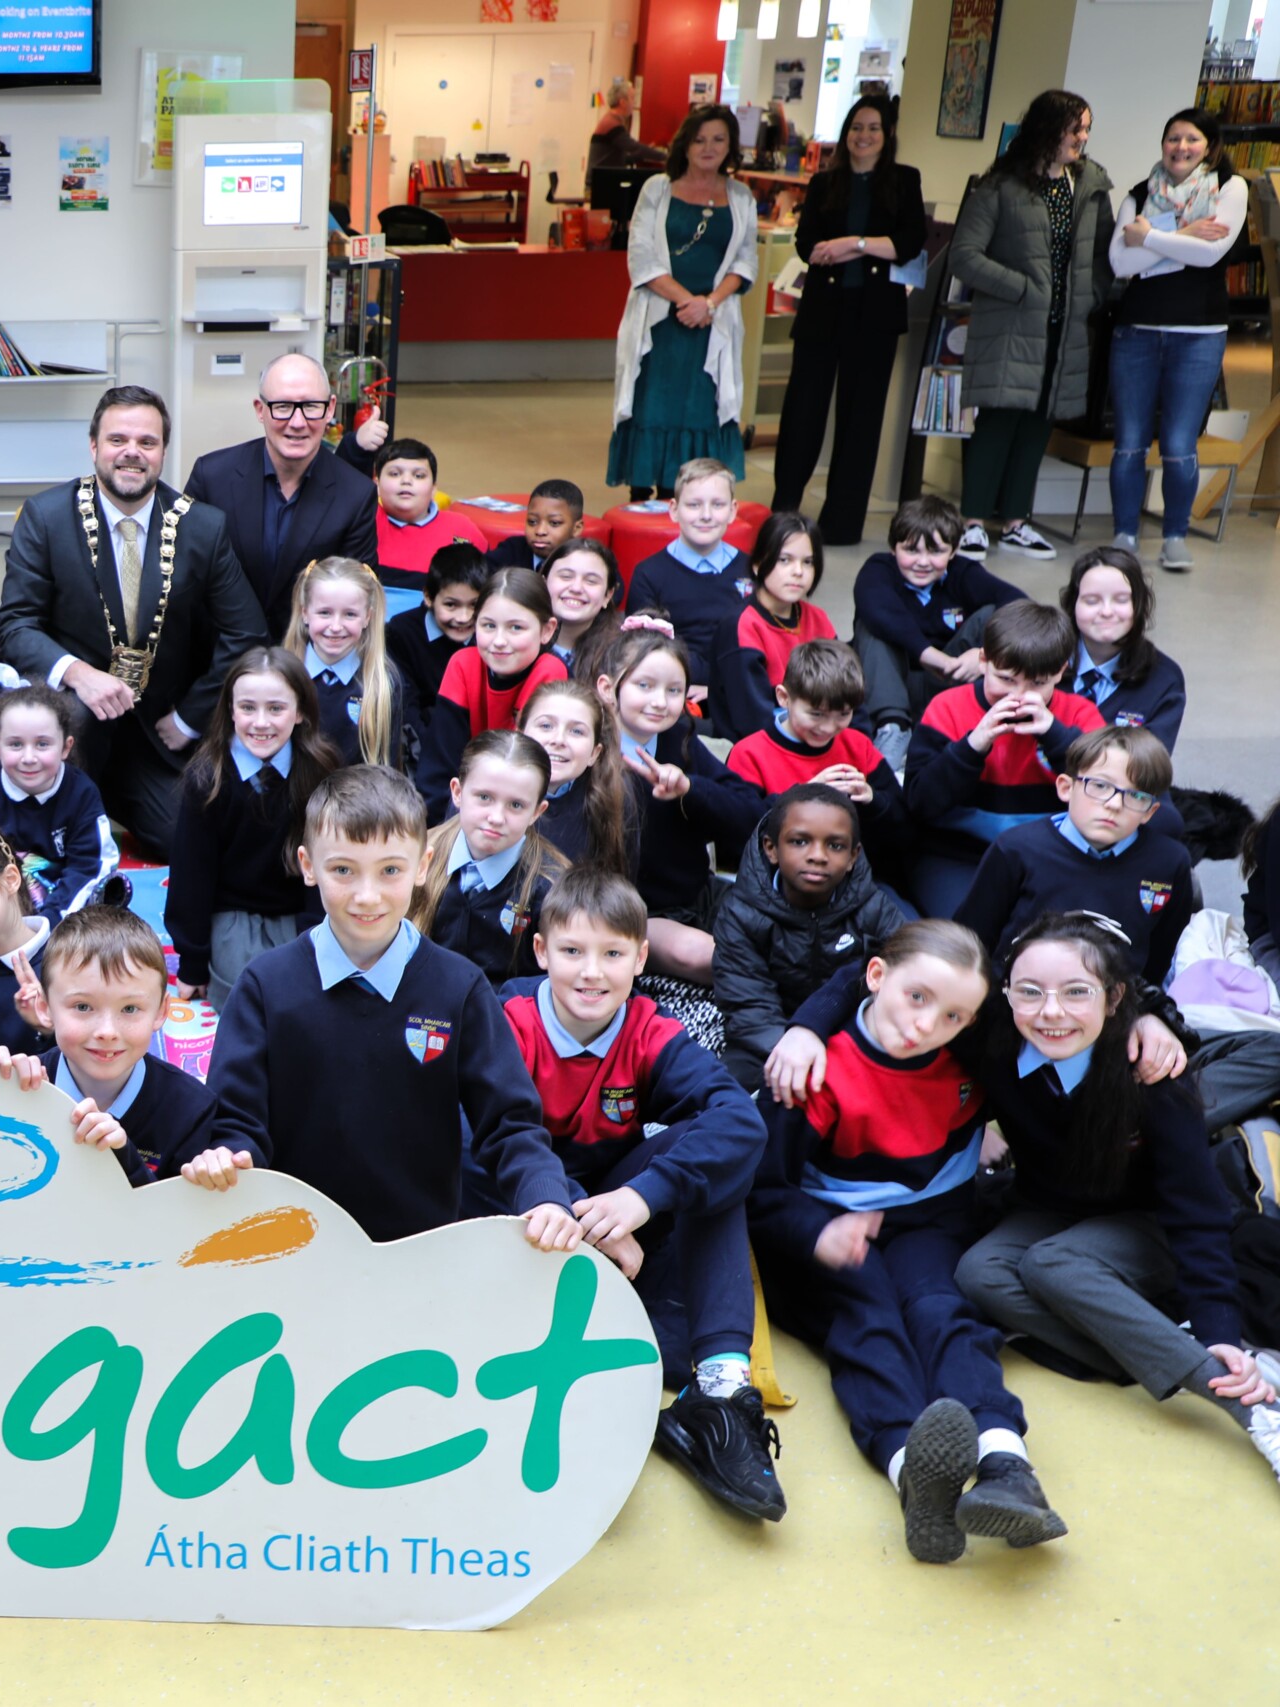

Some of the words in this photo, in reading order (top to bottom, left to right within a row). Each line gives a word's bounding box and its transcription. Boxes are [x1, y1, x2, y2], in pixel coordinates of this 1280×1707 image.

[42, 6, 92, 16] Eventbrite
[173, 1039, 210, 1049] nicor
[145, 1524, 247, 1569] Átha
[263, 1533, 388, 1573] Cliath
[401, 1537, 531, 1577] Theas
